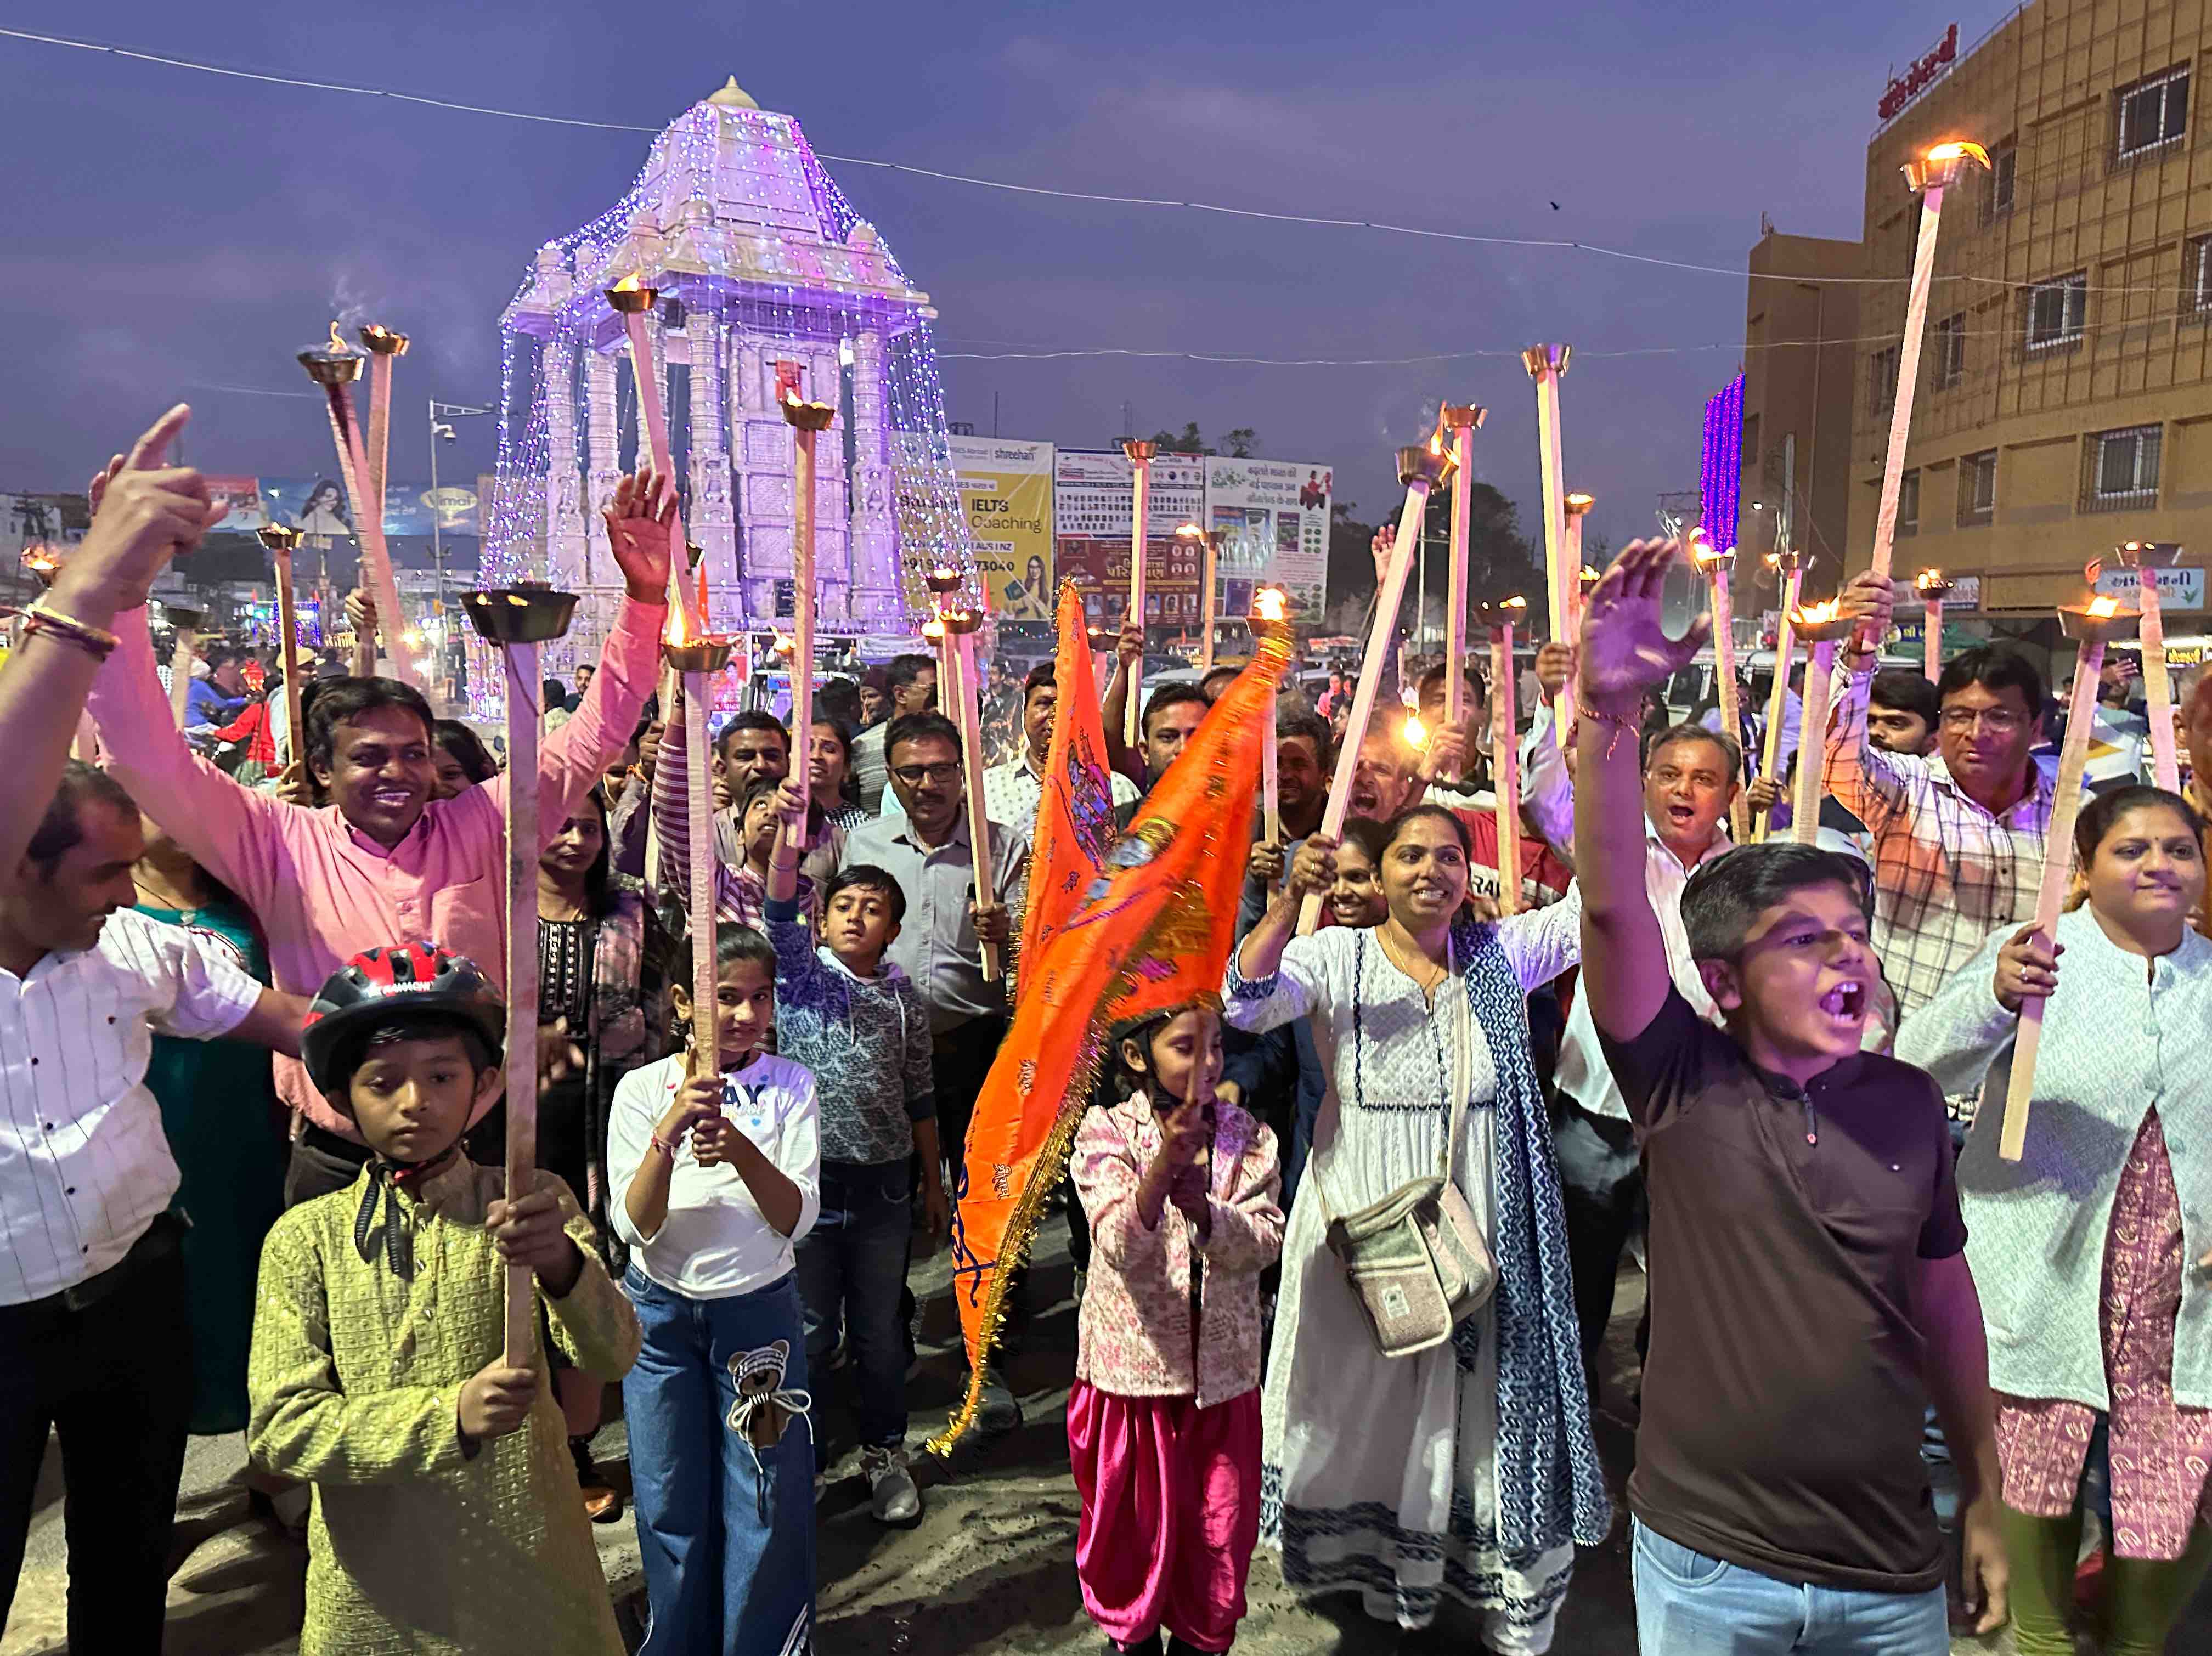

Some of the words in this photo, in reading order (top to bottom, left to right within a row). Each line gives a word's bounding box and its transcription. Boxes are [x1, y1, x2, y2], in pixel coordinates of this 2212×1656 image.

[972, 499, 1009, 512] IELTS
[972, 516, 1041, 533] Coaching
[992, 1163, 1012, 1200] श्रीराम
